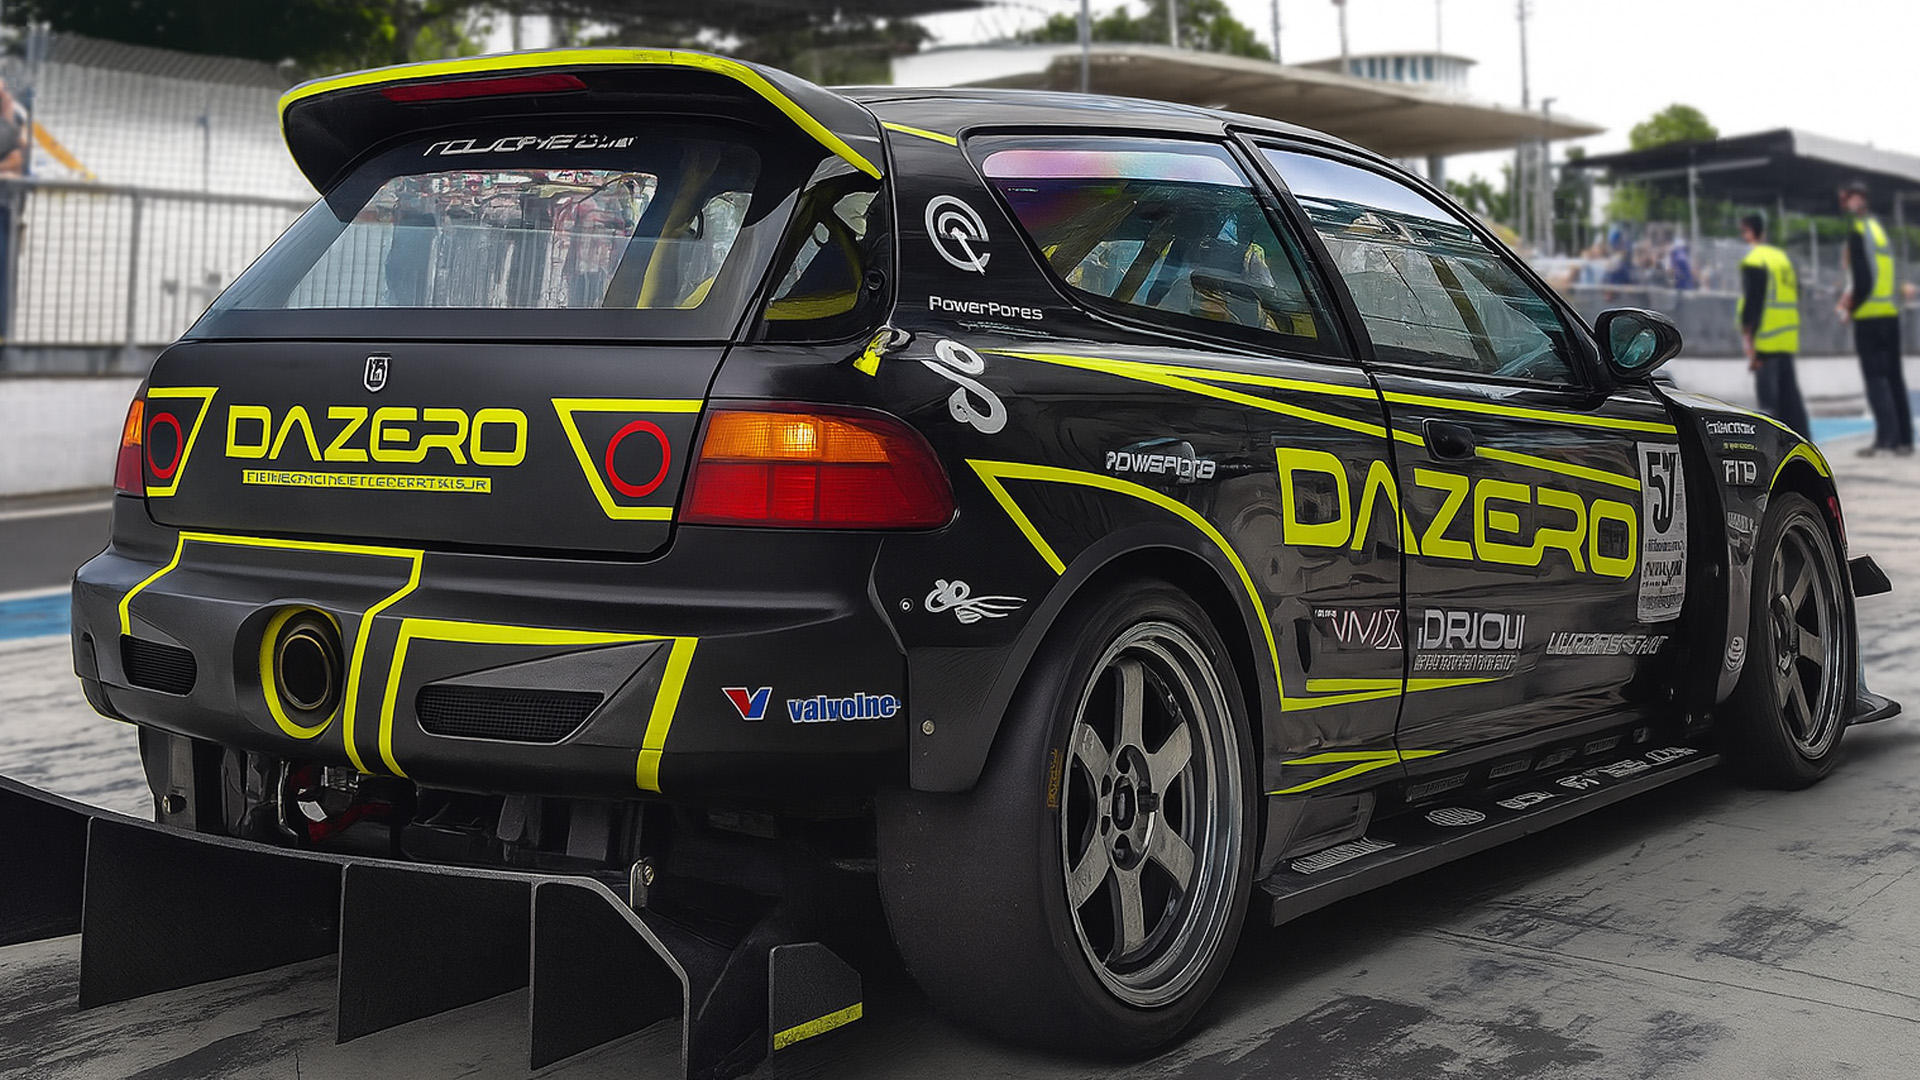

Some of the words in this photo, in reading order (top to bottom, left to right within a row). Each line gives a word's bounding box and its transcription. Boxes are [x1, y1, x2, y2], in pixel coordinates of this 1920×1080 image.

[928, 295, 1044, 321] PowerPores
[225, 404, 529, 467] DAZERO
[1275, 446, 1638, 580] DAZERO
